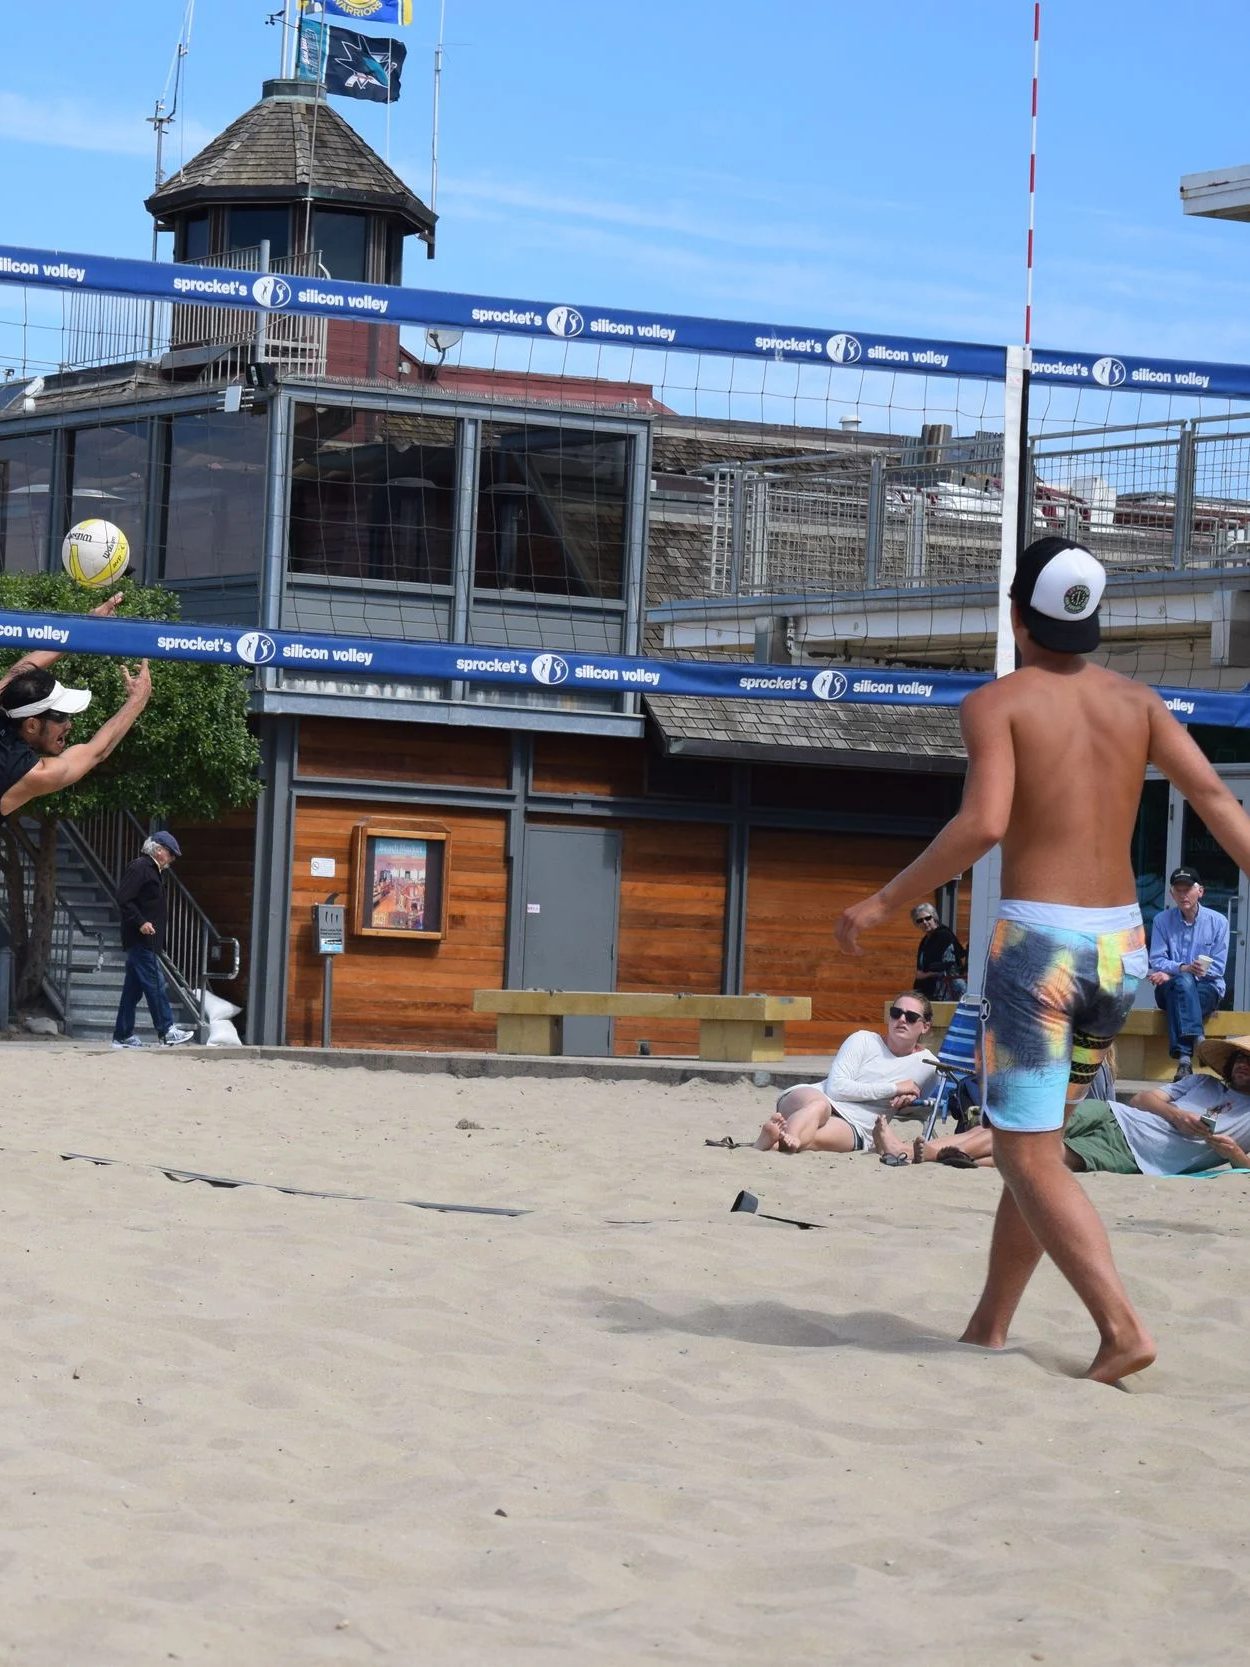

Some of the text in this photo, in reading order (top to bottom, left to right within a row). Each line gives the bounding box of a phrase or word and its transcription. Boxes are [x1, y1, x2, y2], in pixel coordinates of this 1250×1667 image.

[42, 263, 86, 283] volley
[173, 276, 389, 314] sprocket's silicon volley
[471, 306, 676, 342] sprocket's silicon volley
[754, 335, 949, 368] sprocket's silicon volley
[1030, 361, 1210, 389] procket's silicon volley
[26, 625, 70, 644] volley
[157, 635, 374, 666] sprocket's silicon volley
[455, 657, 661, 686] sprocket's silicon volley
[739, 676, 933, 698] sprocket's silicon volley
